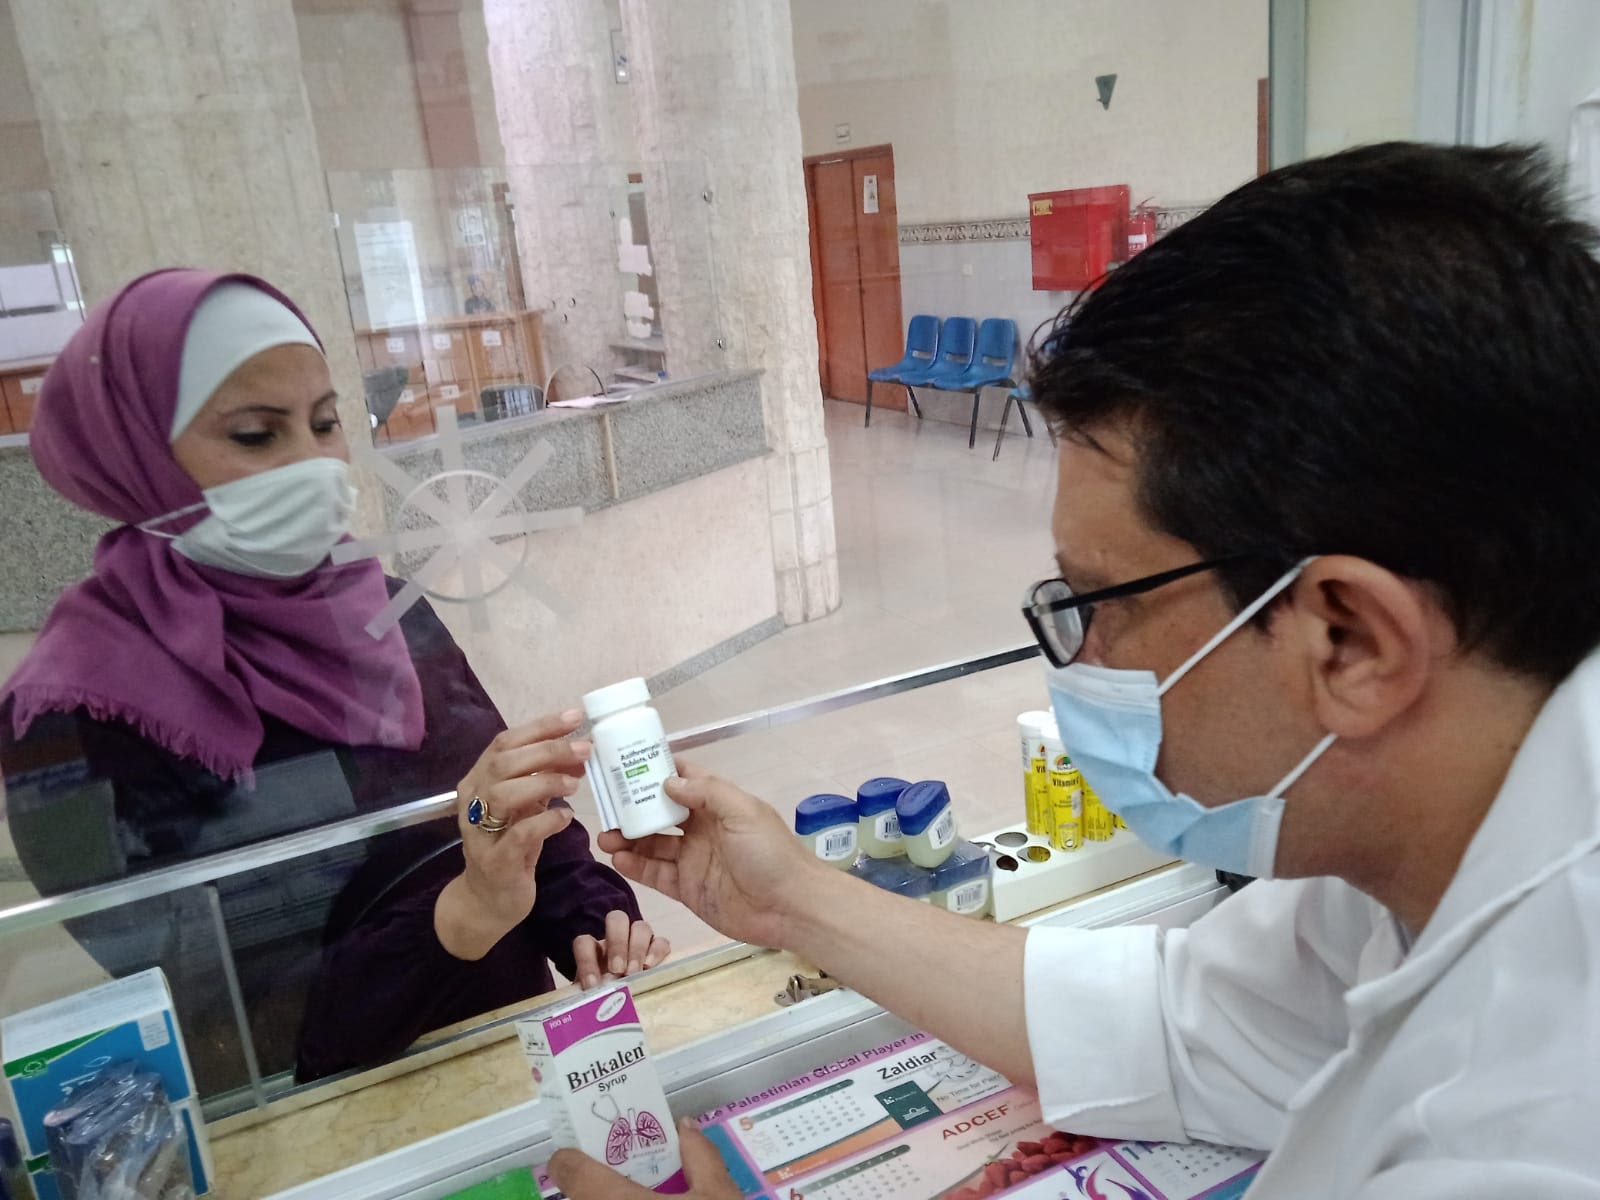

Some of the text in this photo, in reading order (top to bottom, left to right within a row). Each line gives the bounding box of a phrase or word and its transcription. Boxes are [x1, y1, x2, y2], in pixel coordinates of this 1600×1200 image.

[566, 1044, 645, 1092] Brikalen
[726, 1075, 811, 1113] Palestinian
[861, 1038, 908, 1060] Player
[877, 1050, 938, 1081] Zaldiar
[598, 1073, 628, 1093] Syrup
[739, 1115, 754, 1131] 5
[941, 1103, 1010, 1141] ADCEF
